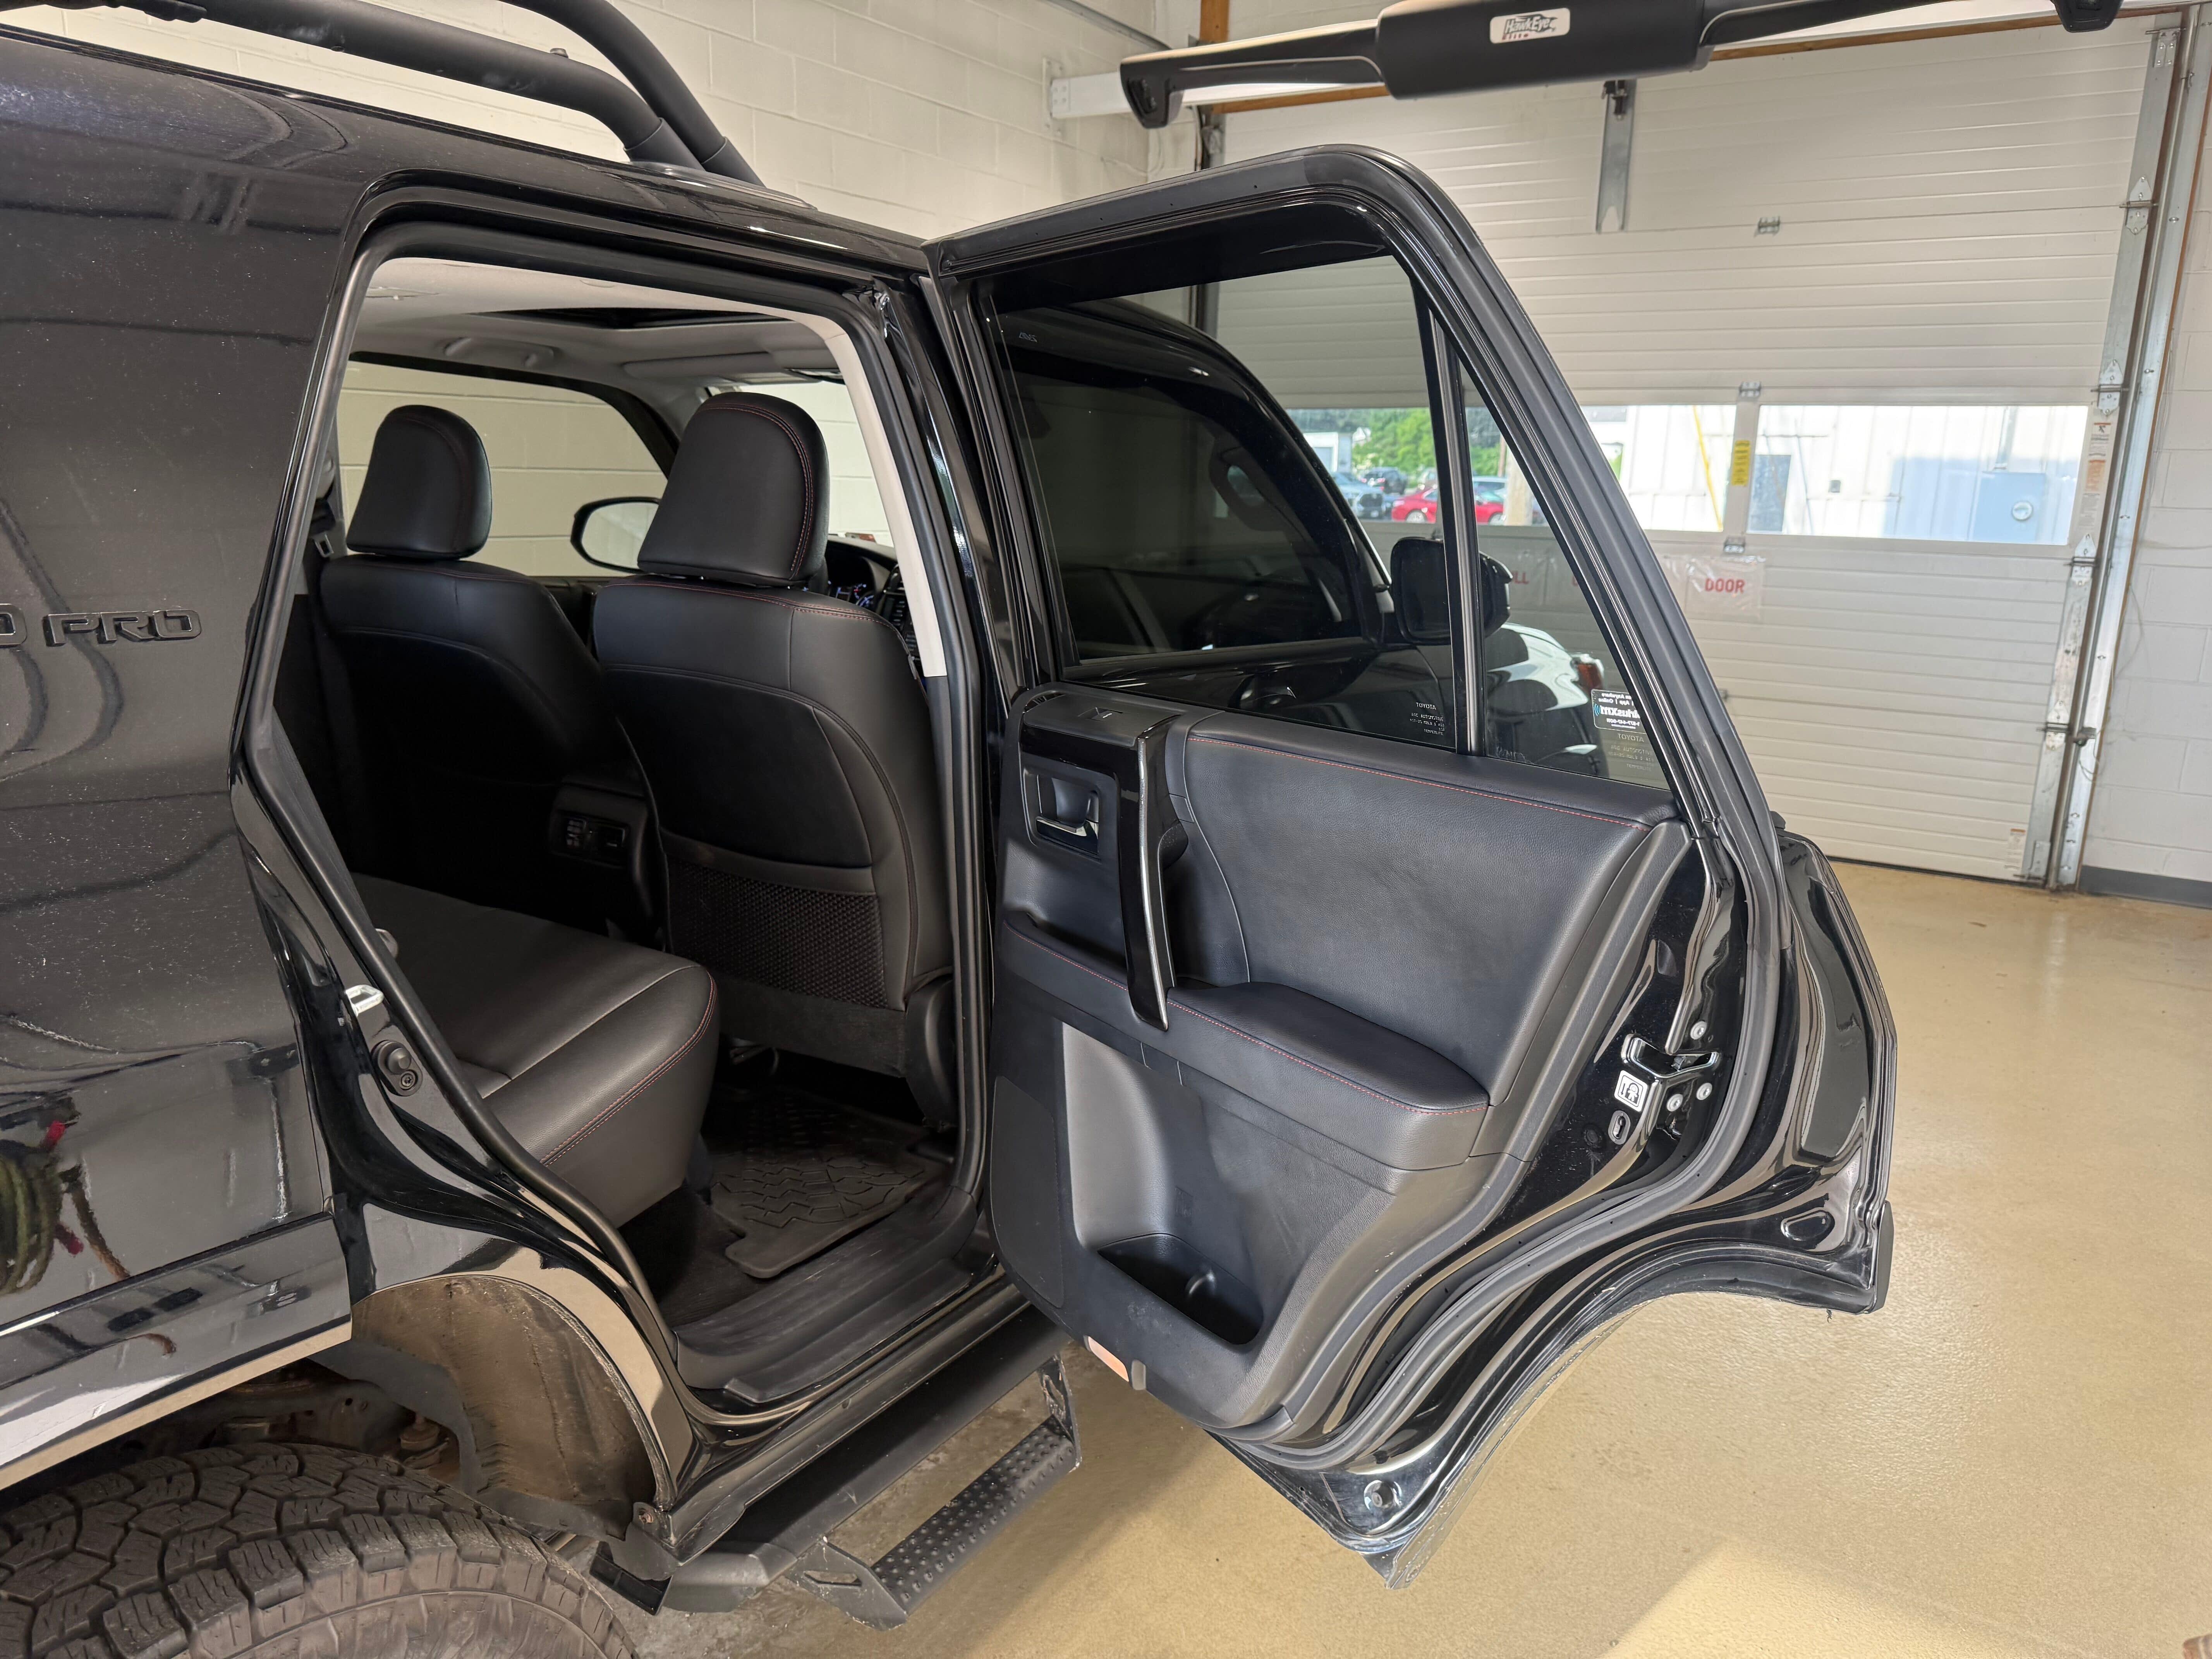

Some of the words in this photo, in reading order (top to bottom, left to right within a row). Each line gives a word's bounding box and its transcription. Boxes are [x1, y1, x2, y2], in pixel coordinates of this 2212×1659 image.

[1504, 16, 1550, 34] HawkEye
[1705, 578, 1745, 594] DOOR
[43, 610, 202, 646] PRO
[1416, 702, 1436, 710] TOYOTA
[1617, 733, 1644, 742] TOYOTA
